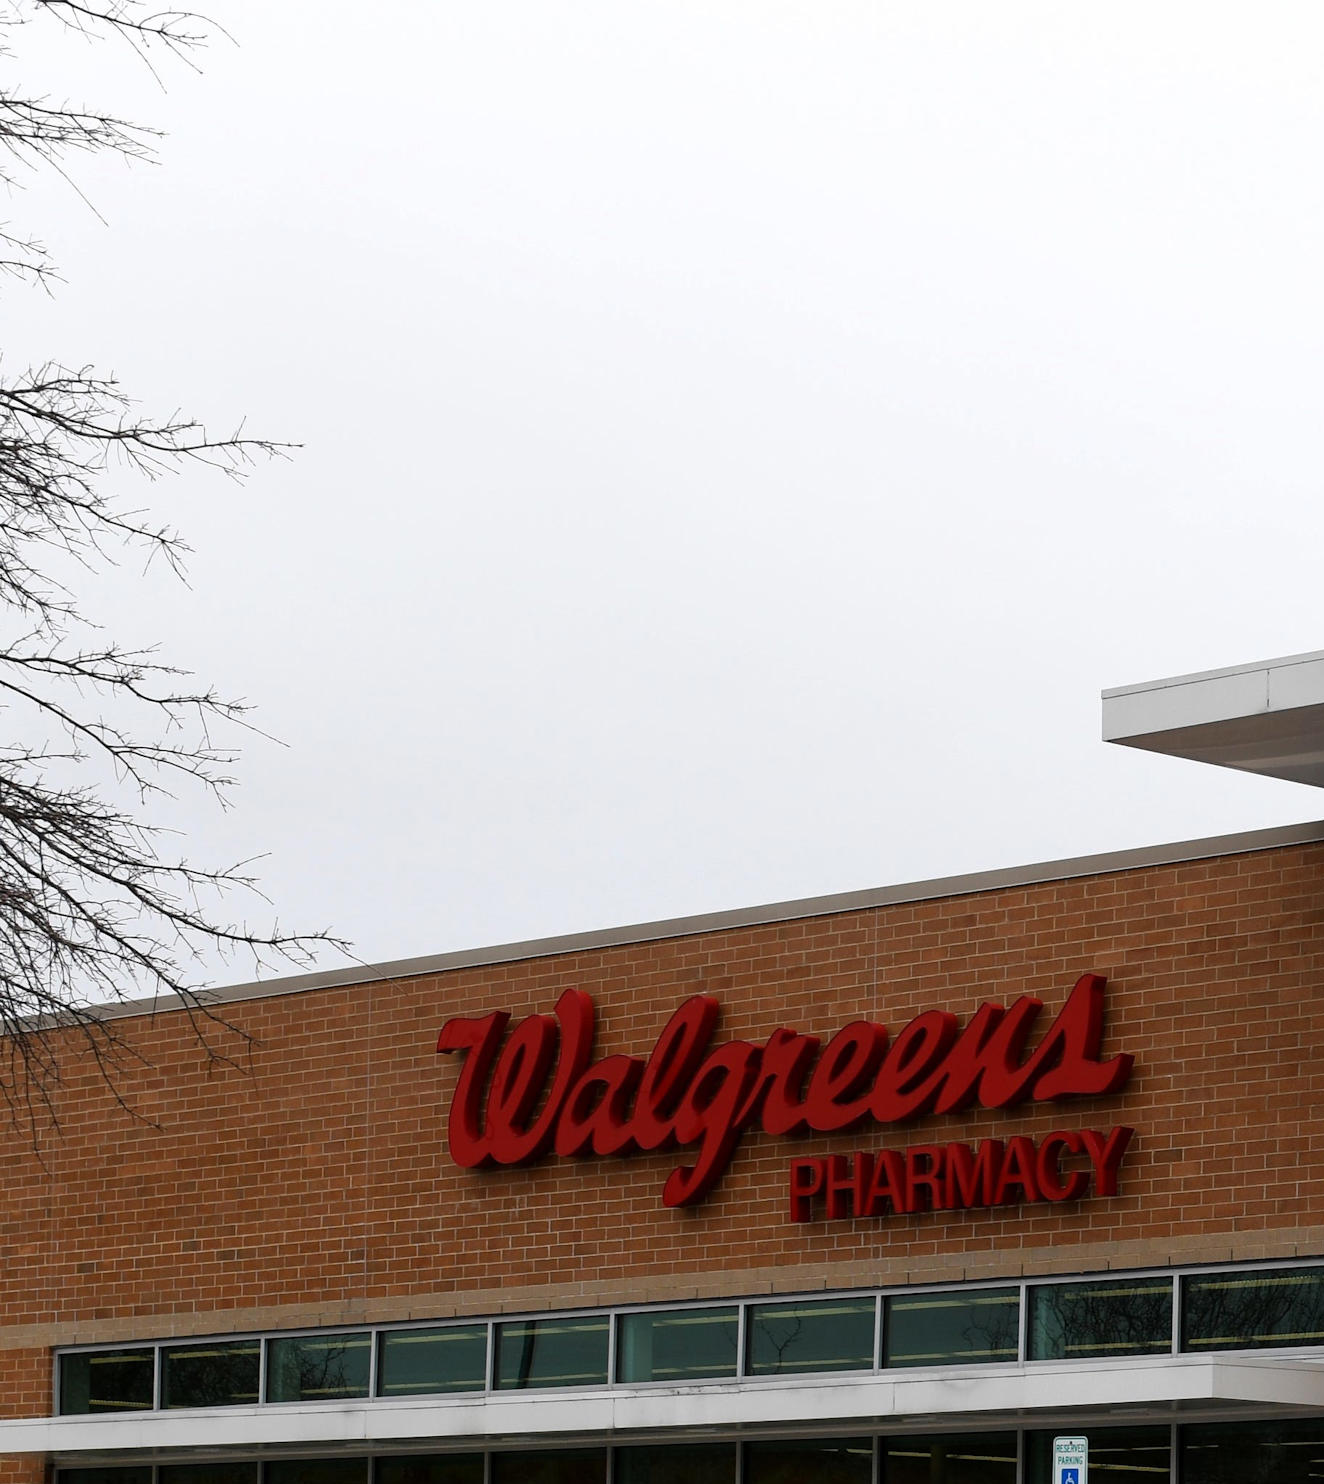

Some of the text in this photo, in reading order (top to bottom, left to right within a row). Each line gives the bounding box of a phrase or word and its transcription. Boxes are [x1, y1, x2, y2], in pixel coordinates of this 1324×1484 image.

[437, 974, 1135, 1208] Walgreens
[789, 1126, 1135, 1222] PHARMACY
[1056, 1444, 1085, 1453] RESERVED
[1057, 1456, 1083, 1465] PARKING
